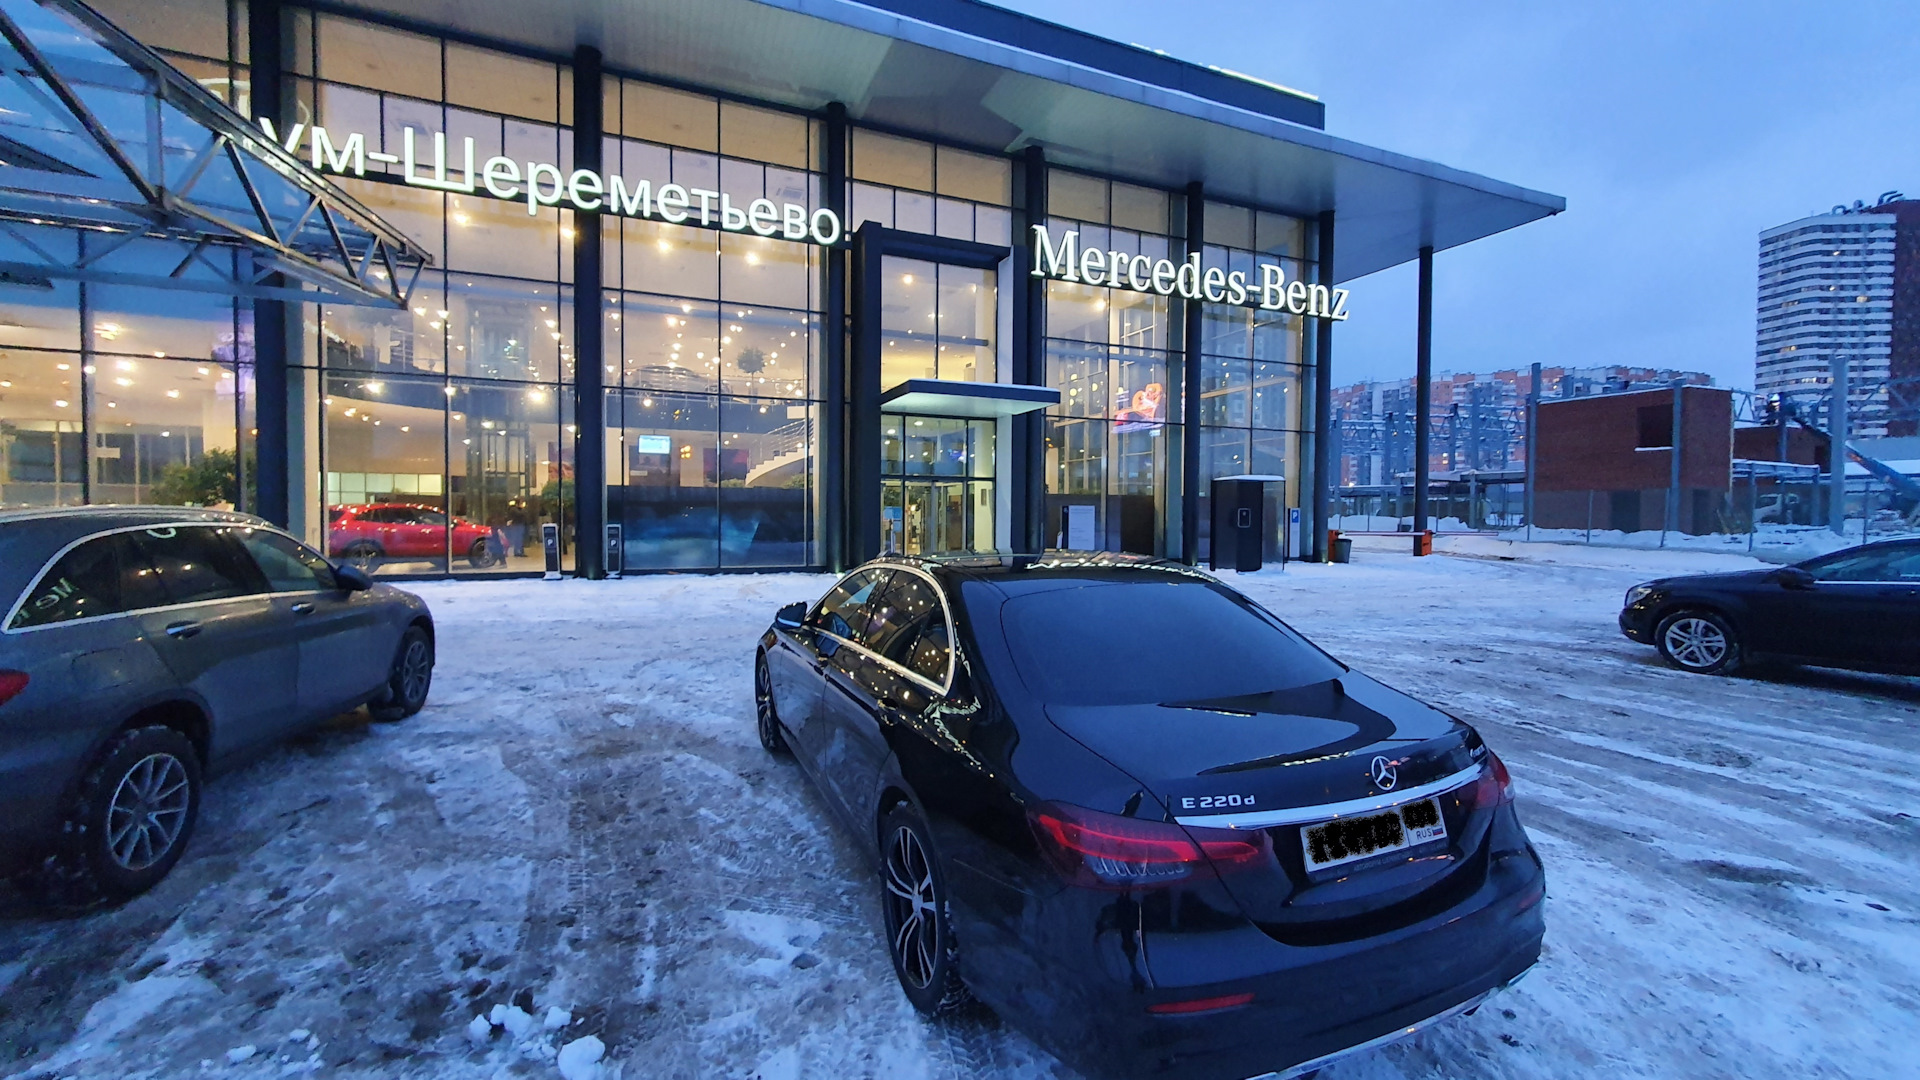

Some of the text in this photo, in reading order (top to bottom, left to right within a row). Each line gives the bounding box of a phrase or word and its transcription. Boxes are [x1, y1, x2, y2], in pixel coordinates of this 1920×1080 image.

[1031, 224, 1350, 321] Mercedes-Benz
[1181, 797, 1196, 809] E
[1416, 828, 1432, 840] RUS
